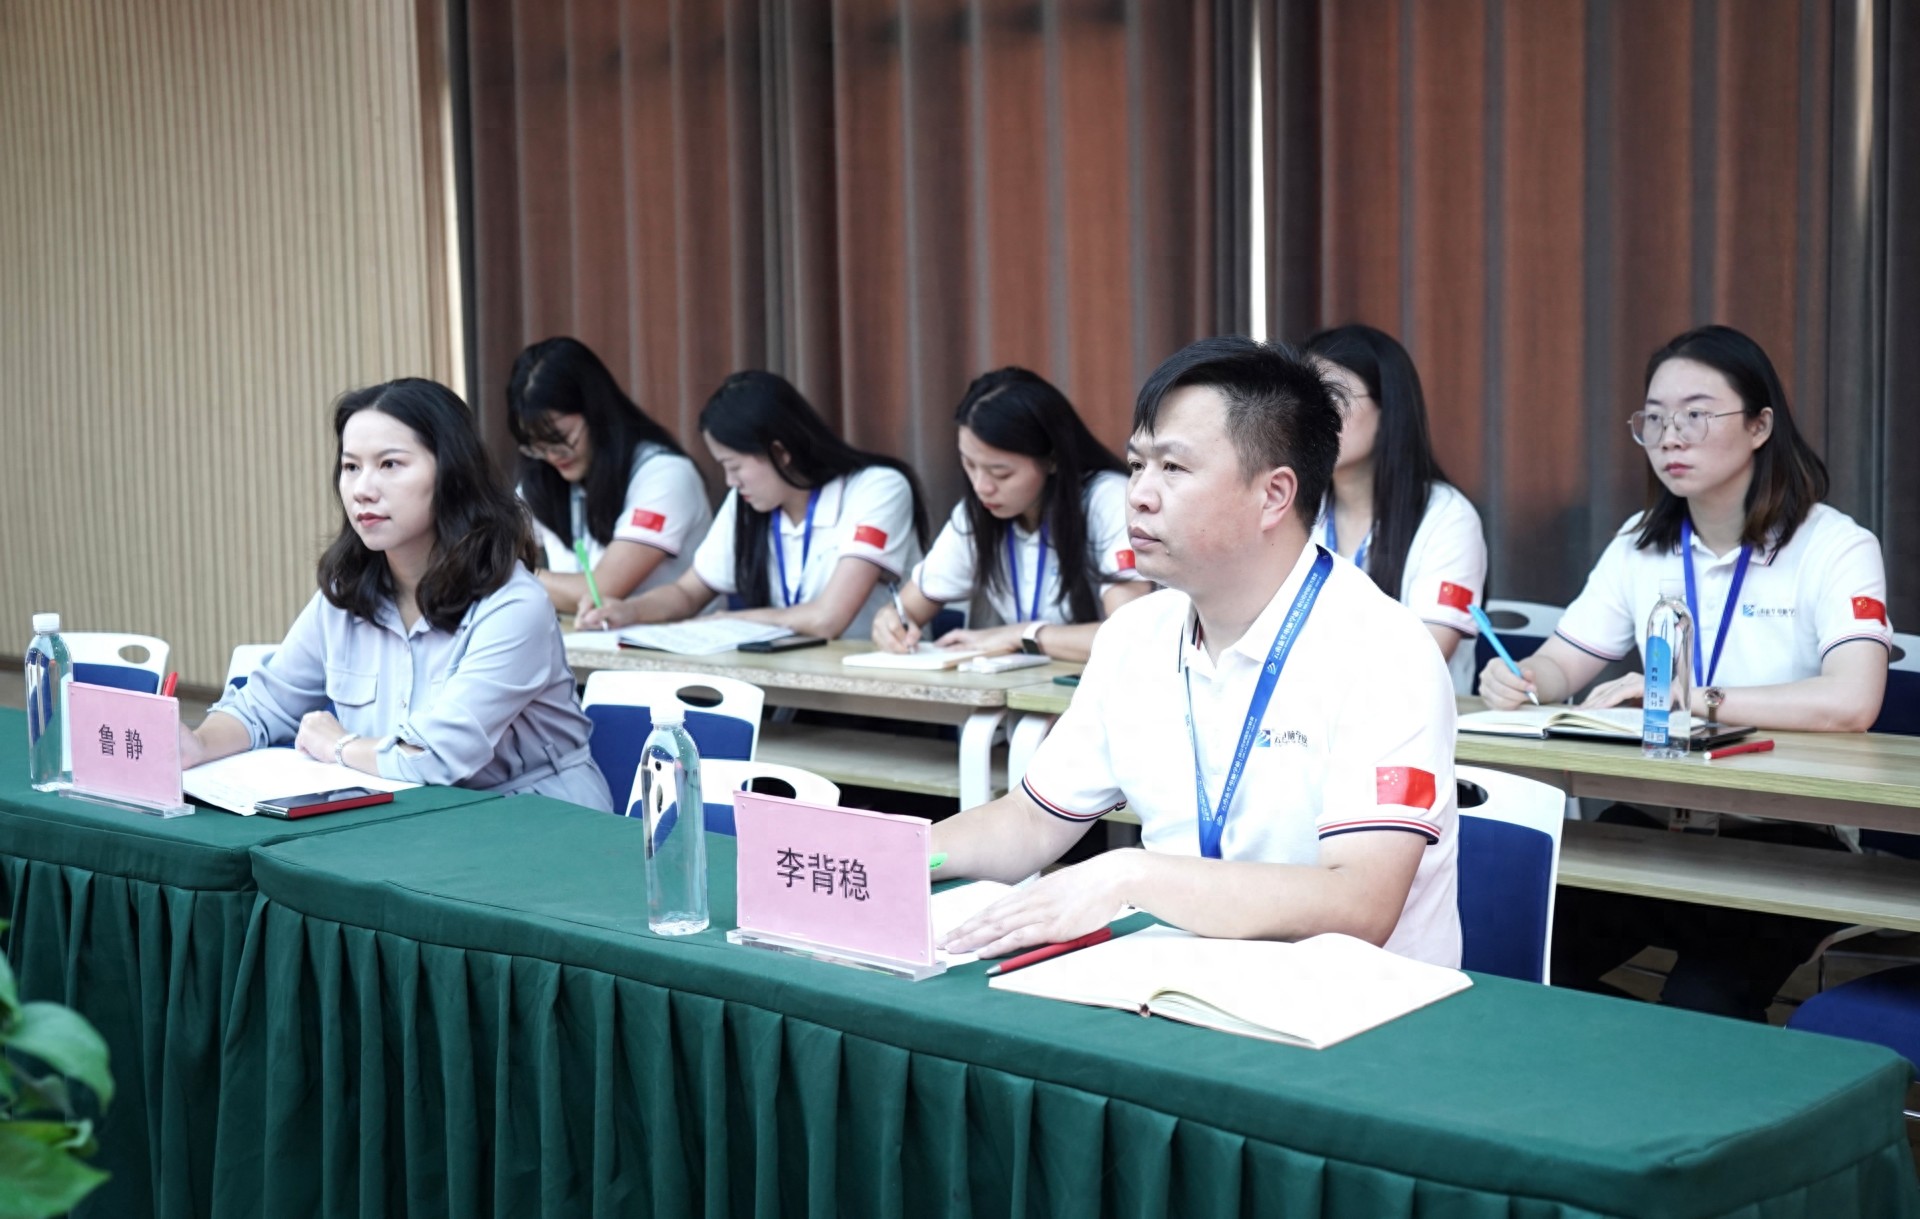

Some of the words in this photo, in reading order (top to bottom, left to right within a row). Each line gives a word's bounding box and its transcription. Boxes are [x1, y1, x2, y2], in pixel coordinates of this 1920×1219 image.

[98, 724, 143, 760] 鲁静
[776, 847, 870, 901] 李背稳
